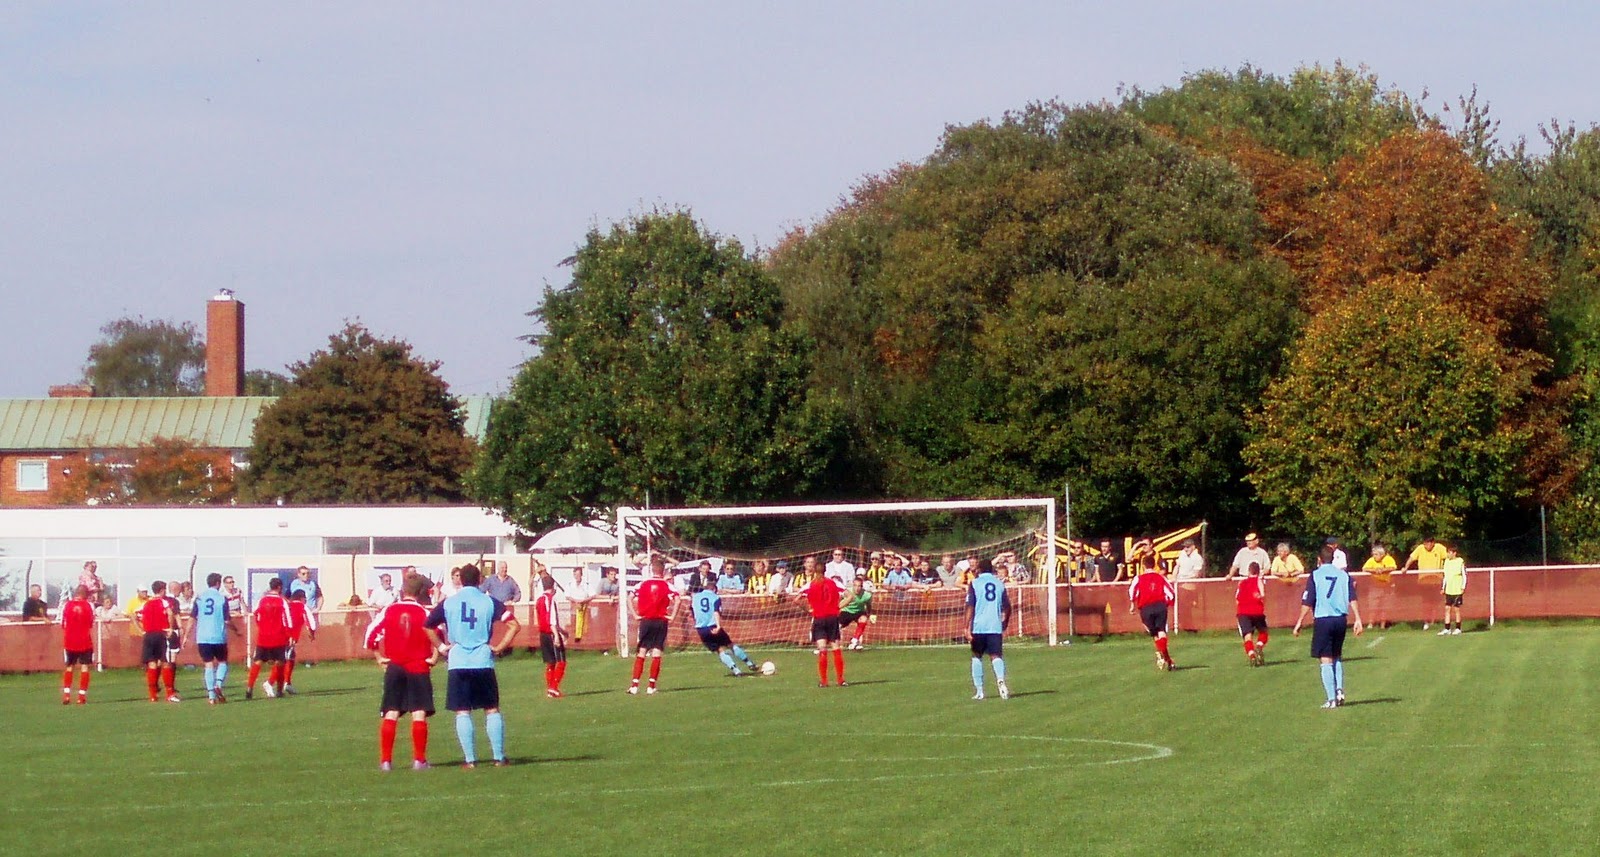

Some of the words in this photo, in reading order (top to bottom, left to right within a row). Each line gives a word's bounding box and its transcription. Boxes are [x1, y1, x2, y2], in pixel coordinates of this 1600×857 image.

[985, 583, 997, 601] 8
[1325, 577, 1338, 599] 7
[204, 598, 215, 615] 3
[700, 597, 710, 613] 9
[461, 602, 478, 629] 4
